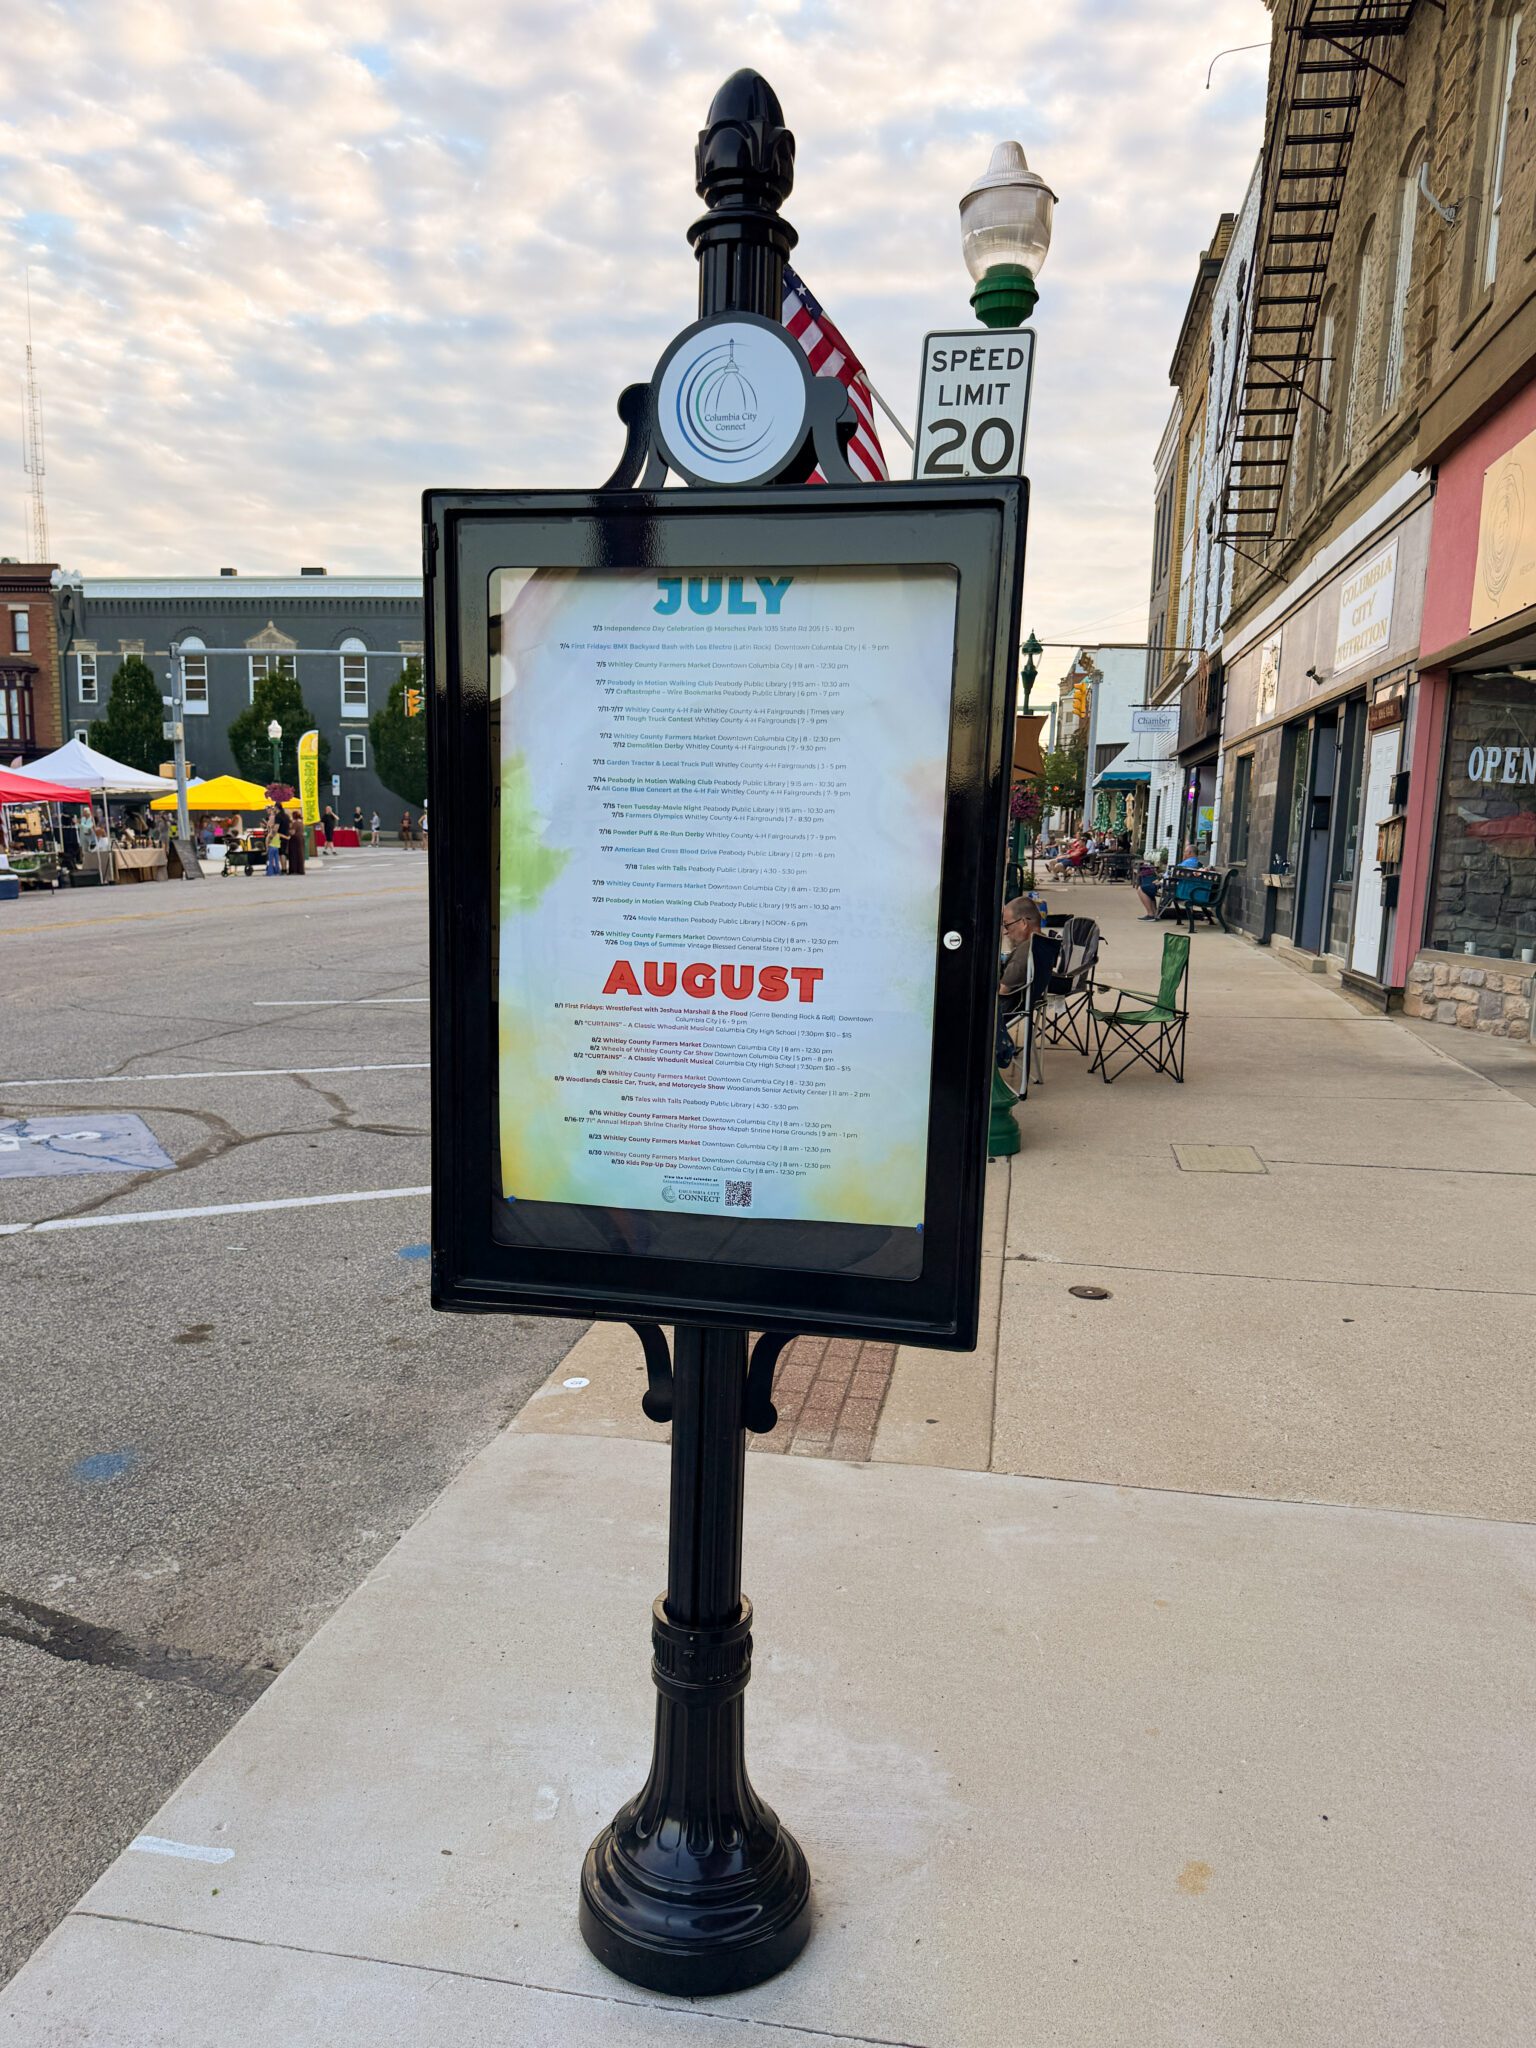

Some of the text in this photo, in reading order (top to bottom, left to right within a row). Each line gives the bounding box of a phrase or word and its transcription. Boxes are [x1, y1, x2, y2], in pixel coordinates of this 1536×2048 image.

[931, 347, 1024, 372] SPEED
[938, 383, 1010, 406] LIMIT
[704, 412, 757, 424] Columbia City
[716, 422, 746, 431] Connect
[924, 418, 1014, 474] 20
[652, 576, 794, 616] JULY
[1342, 554, 1392, 608] COLUMBIA
[1352, 592, 1378, 626] CITY
[1336, 616, 1388, 664] NUTRITION
[1138, 716, 1172, 725] Chamber
[1468, 746, 1536, 785] OPEN
[602, 960, 824, 1003] AUGUST
[678, 1194, 720, 1202] CONNECT
